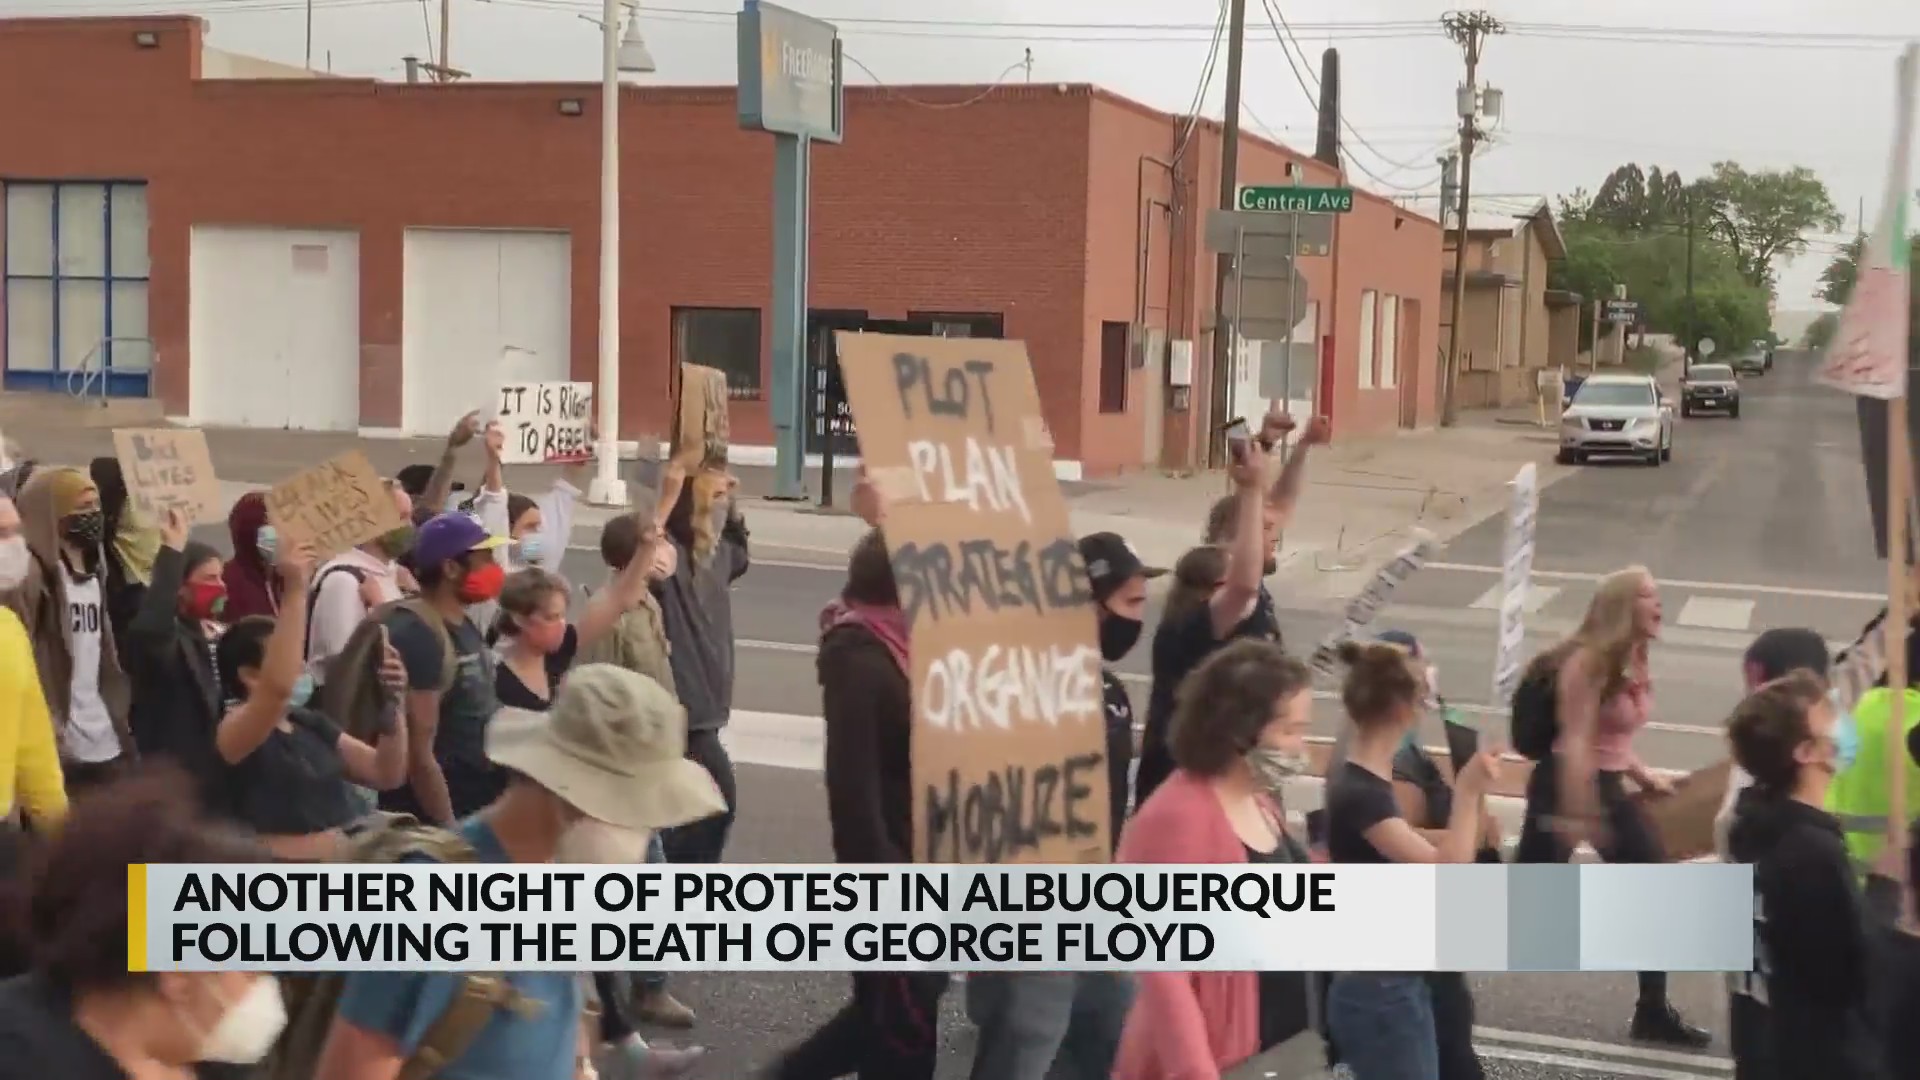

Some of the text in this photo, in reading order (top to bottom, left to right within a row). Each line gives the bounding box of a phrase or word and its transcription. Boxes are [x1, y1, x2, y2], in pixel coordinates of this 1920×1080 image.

[1241, 188, 1351, 211] Central Ave
[500, 386, 527, 415] IT
[892, 352, 994, 434] PLOT
[518, 421, 540, 455] TO
[908, 436, 1032, 524] PLAN
[891, 538, 1094, 625] STRATEGIZE
[923, 644, 1103, 732] ORGANIZE
[926, 753, 1103, 862] MOBILIZE
